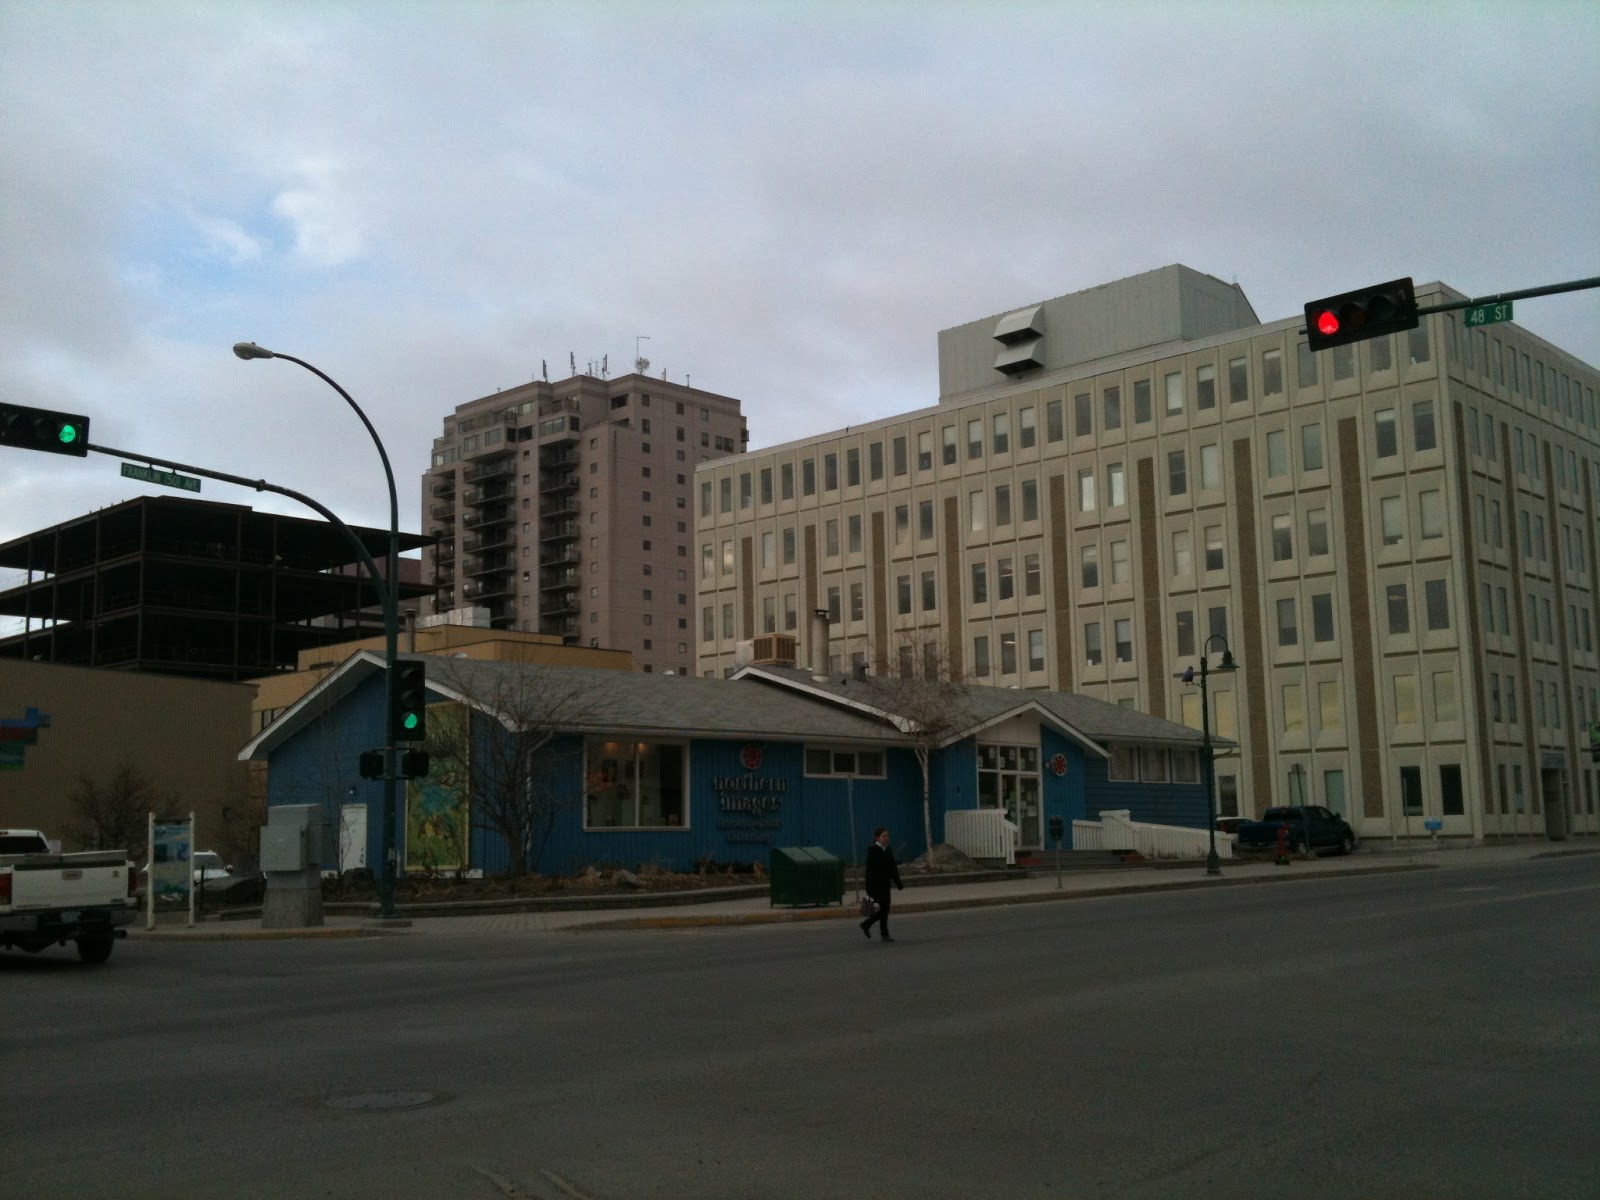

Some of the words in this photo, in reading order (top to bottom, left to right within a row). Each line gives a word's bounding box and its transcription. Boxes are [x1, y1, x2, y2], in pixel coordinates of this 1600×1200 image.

[1470, 309, 1485, 323] 48
[1495, 305, 1507, 320] ST
[123, 464, 160, 482] FRANKLIN
[713, 773, 787, 790] northern
[720, 791, 782, 814] images
